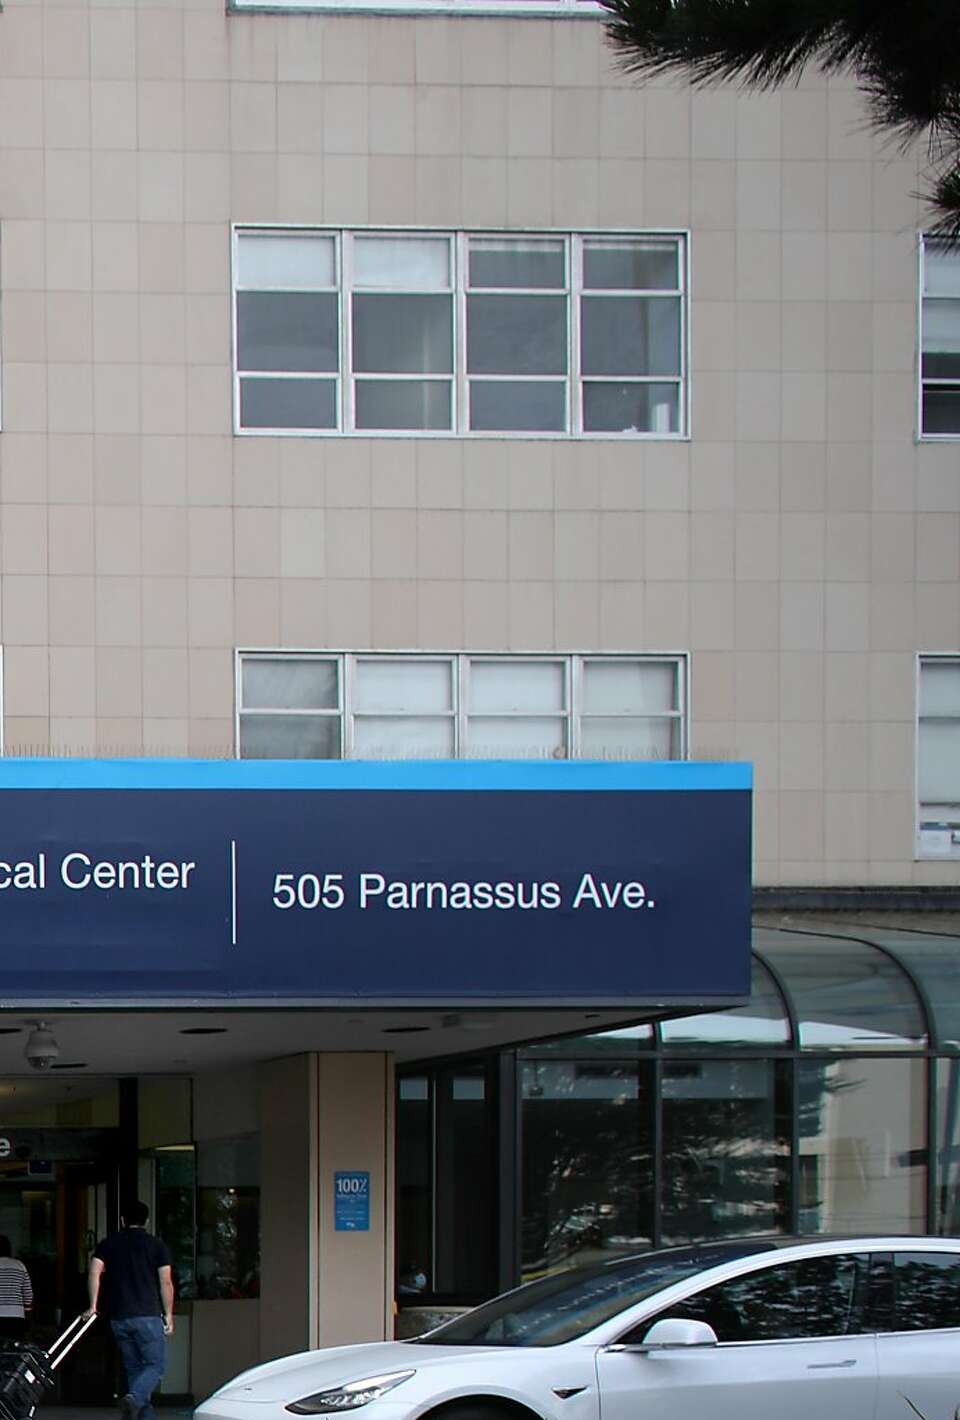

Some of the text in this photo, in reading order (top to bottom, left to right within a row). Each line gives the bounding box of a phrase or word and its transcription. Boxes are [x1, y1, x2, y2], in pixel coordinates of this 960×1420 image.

[60, 852, 196, 890] Center
[271, 873, 656, 909] 505 Parnassus Ave.
[337, 1178, 368, 1193] 100%
